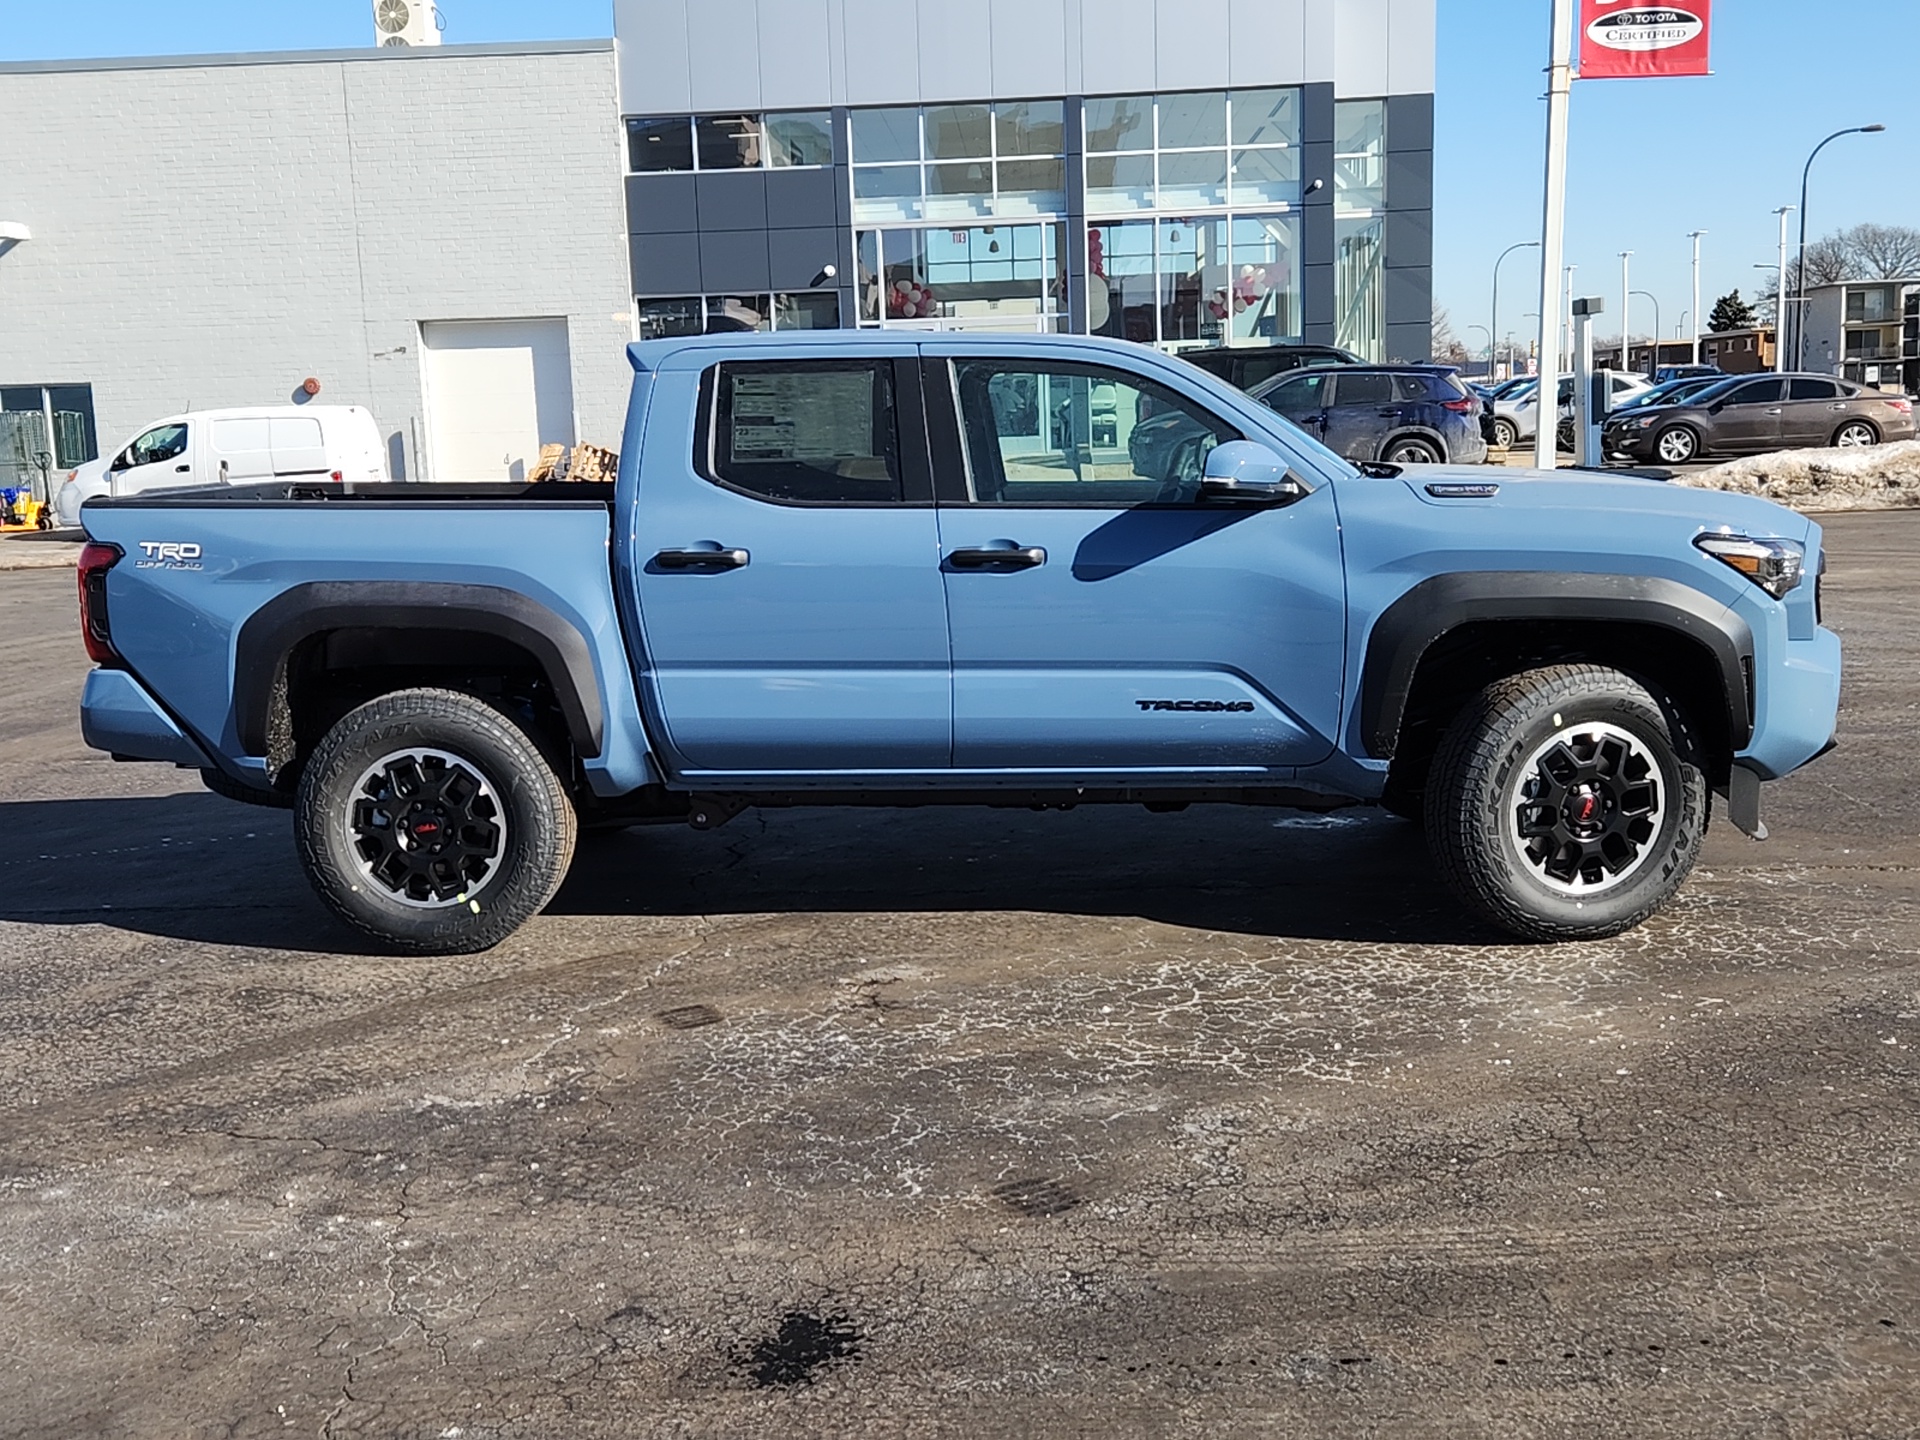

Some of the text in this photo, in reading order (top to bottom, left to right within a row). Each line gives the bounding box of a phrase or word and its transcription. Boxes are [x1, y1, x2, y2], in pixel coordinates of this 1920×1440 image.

[1635, 13, 1678, 24] TOYOTA
[1605, 30, 1687, 41] CERTIFIED
[139, 541, 202, 561] TRD
[1135, 700, 1255, 712] TACOMA
